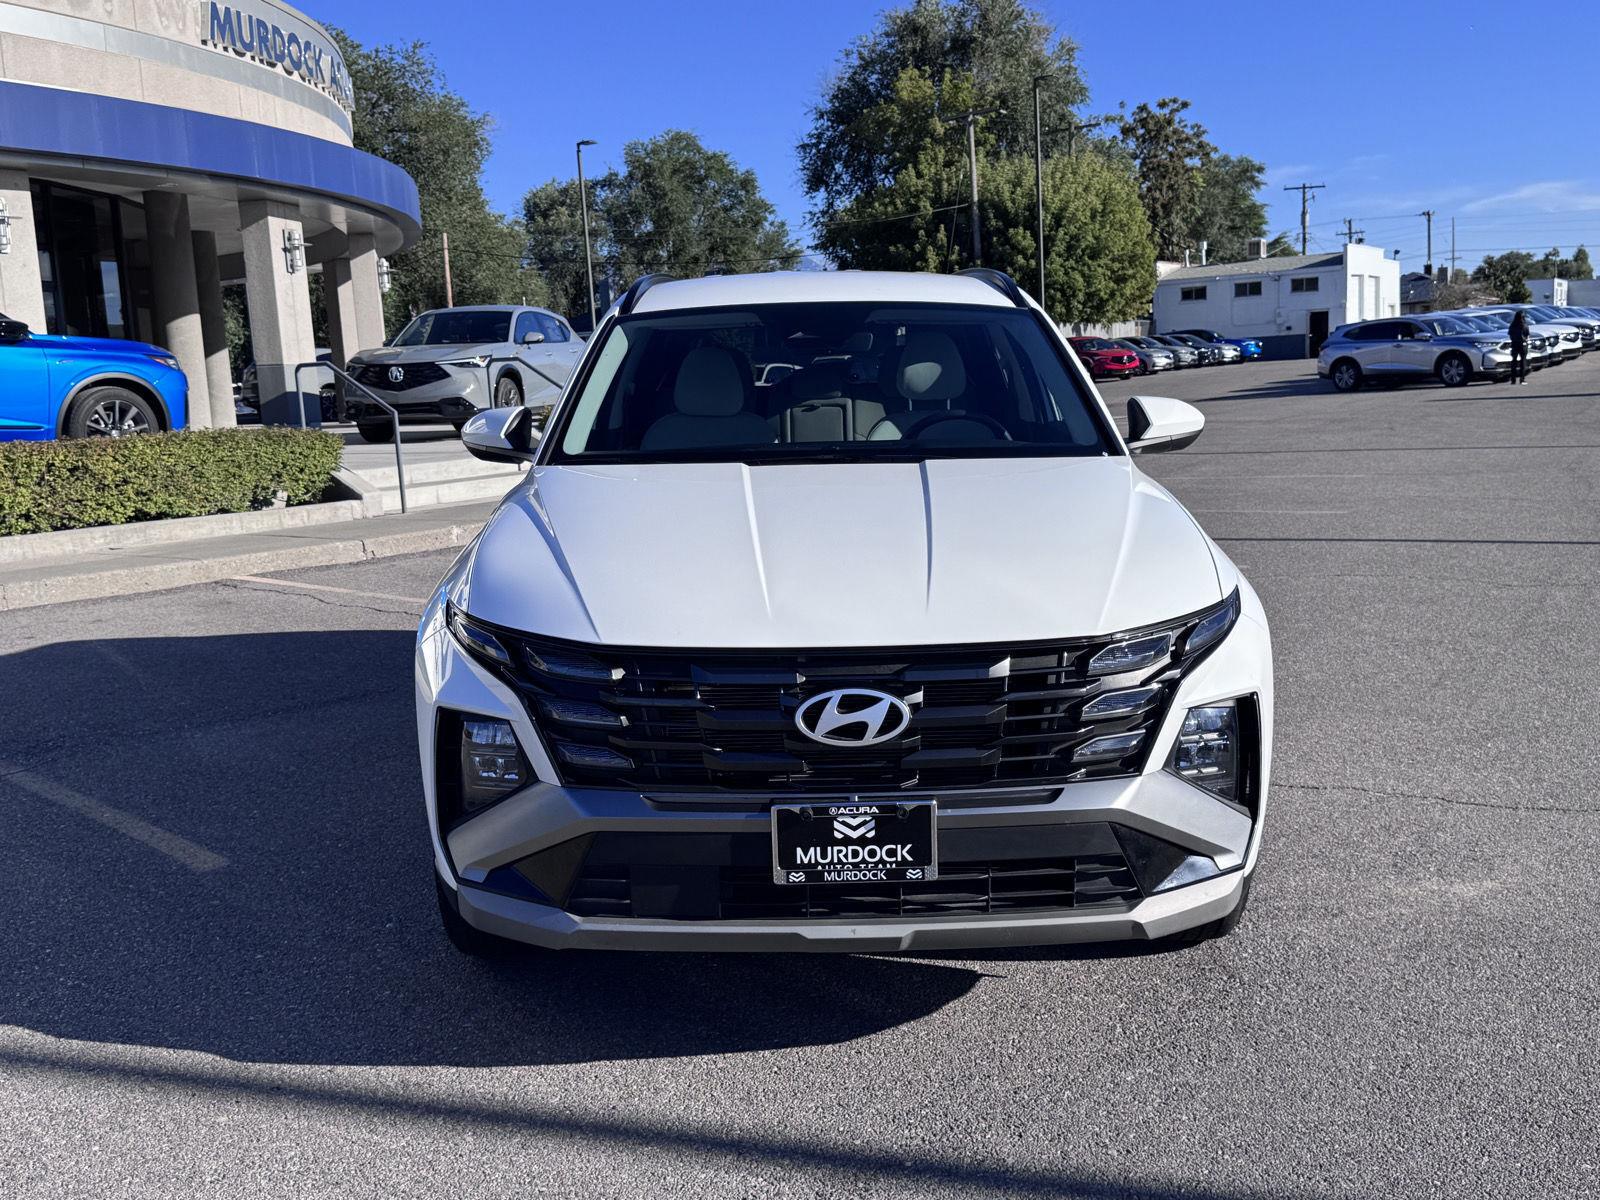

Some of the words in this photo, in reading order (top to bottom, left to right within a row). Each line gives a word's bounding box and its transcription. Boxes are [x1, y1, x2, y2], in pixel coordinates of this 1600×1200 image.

[210, 1, 326, 84] MURDOCK
[838, 806, 878, 814] ACURA
[796, 844, 913, 864] MURDOCK
[824, 870, 887, 882] MURDOCK
